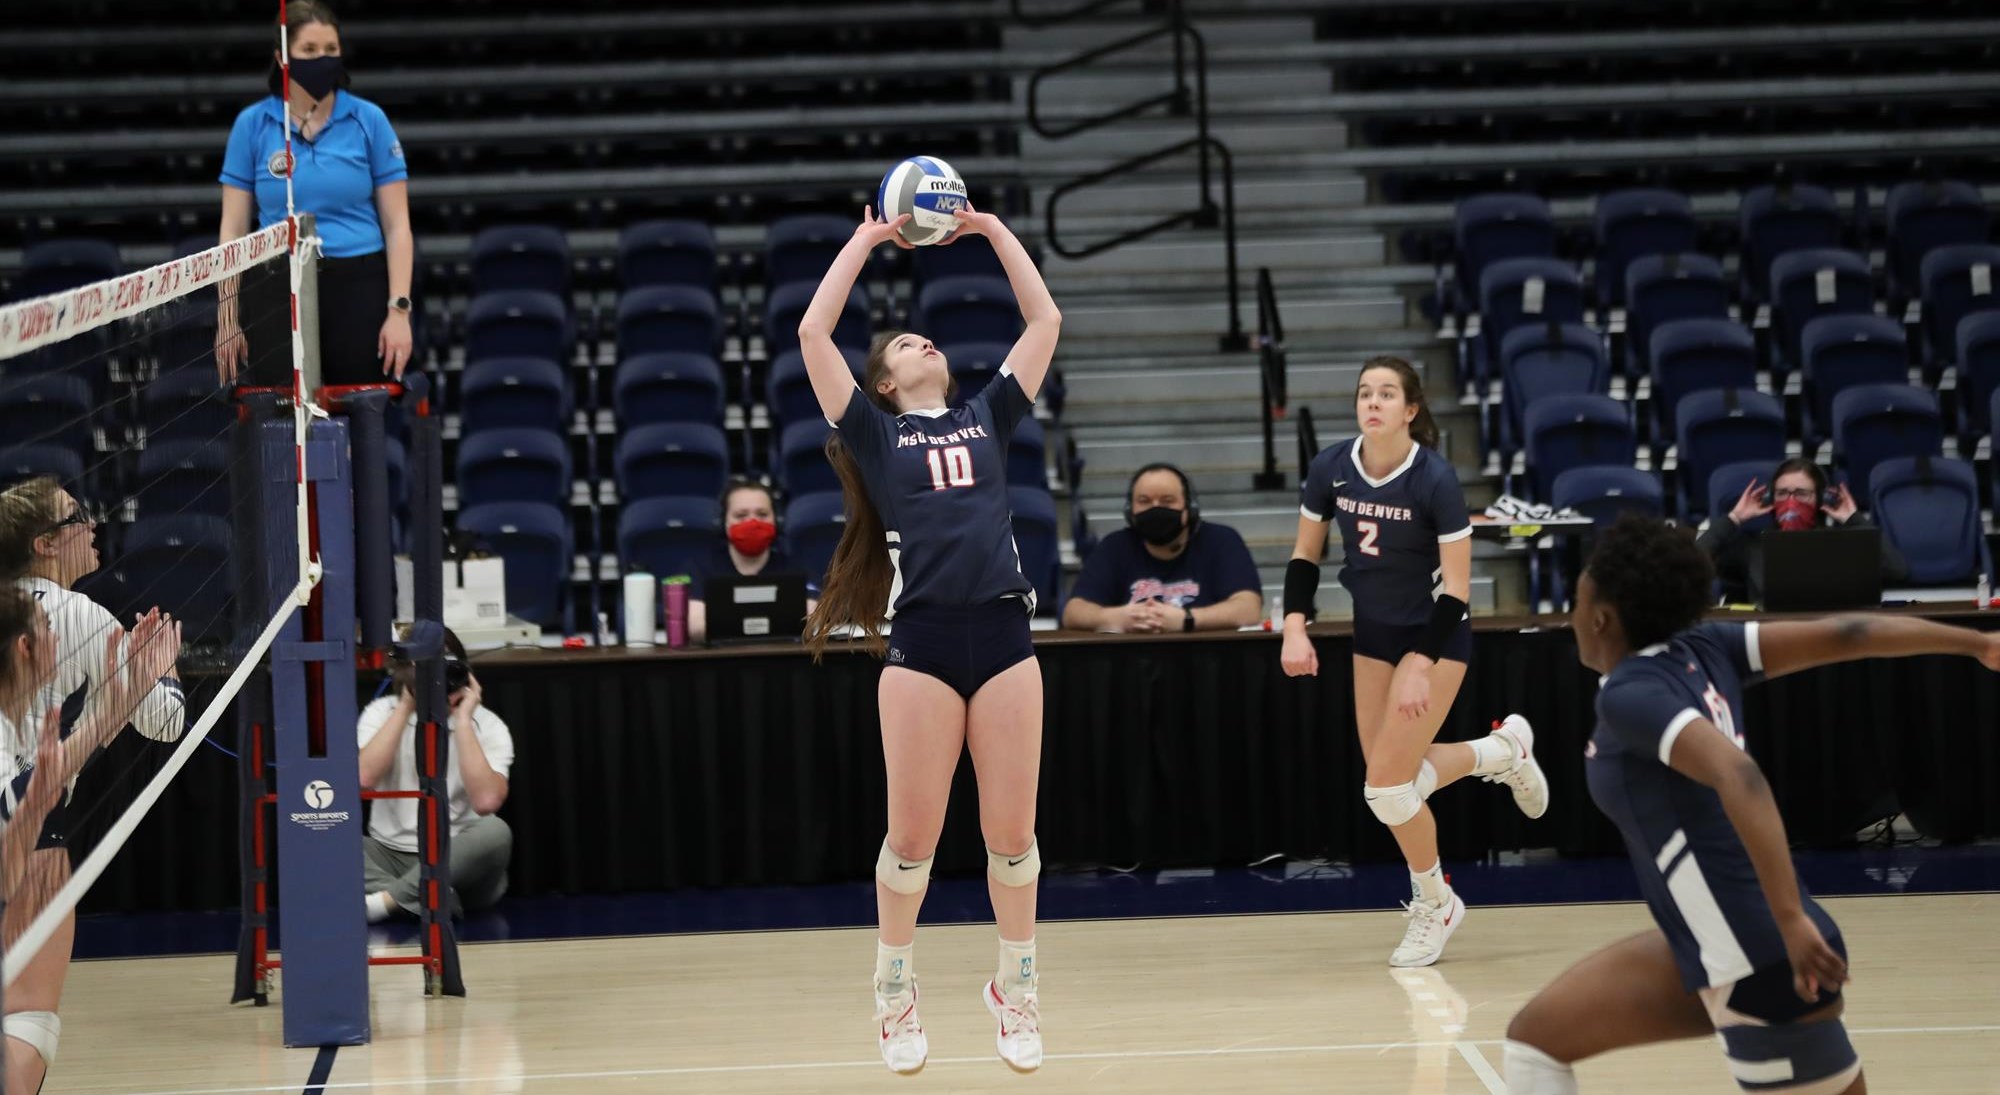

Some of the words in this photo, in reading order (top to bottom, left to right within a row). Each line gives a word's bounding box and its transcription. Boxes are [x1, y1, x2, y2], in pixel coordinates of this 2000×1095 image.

[896, 431, 927, 448] MSU
[927, 424, 988, 445] DENVER
[926, 445, 976, 491] 10
[1335, 496, 1357, 514] MSU
[1357, 501, 1413, 521] DENVER
[1356, 520, 1381, 557] 2
[290, 812, 318, 822] SPORTS
